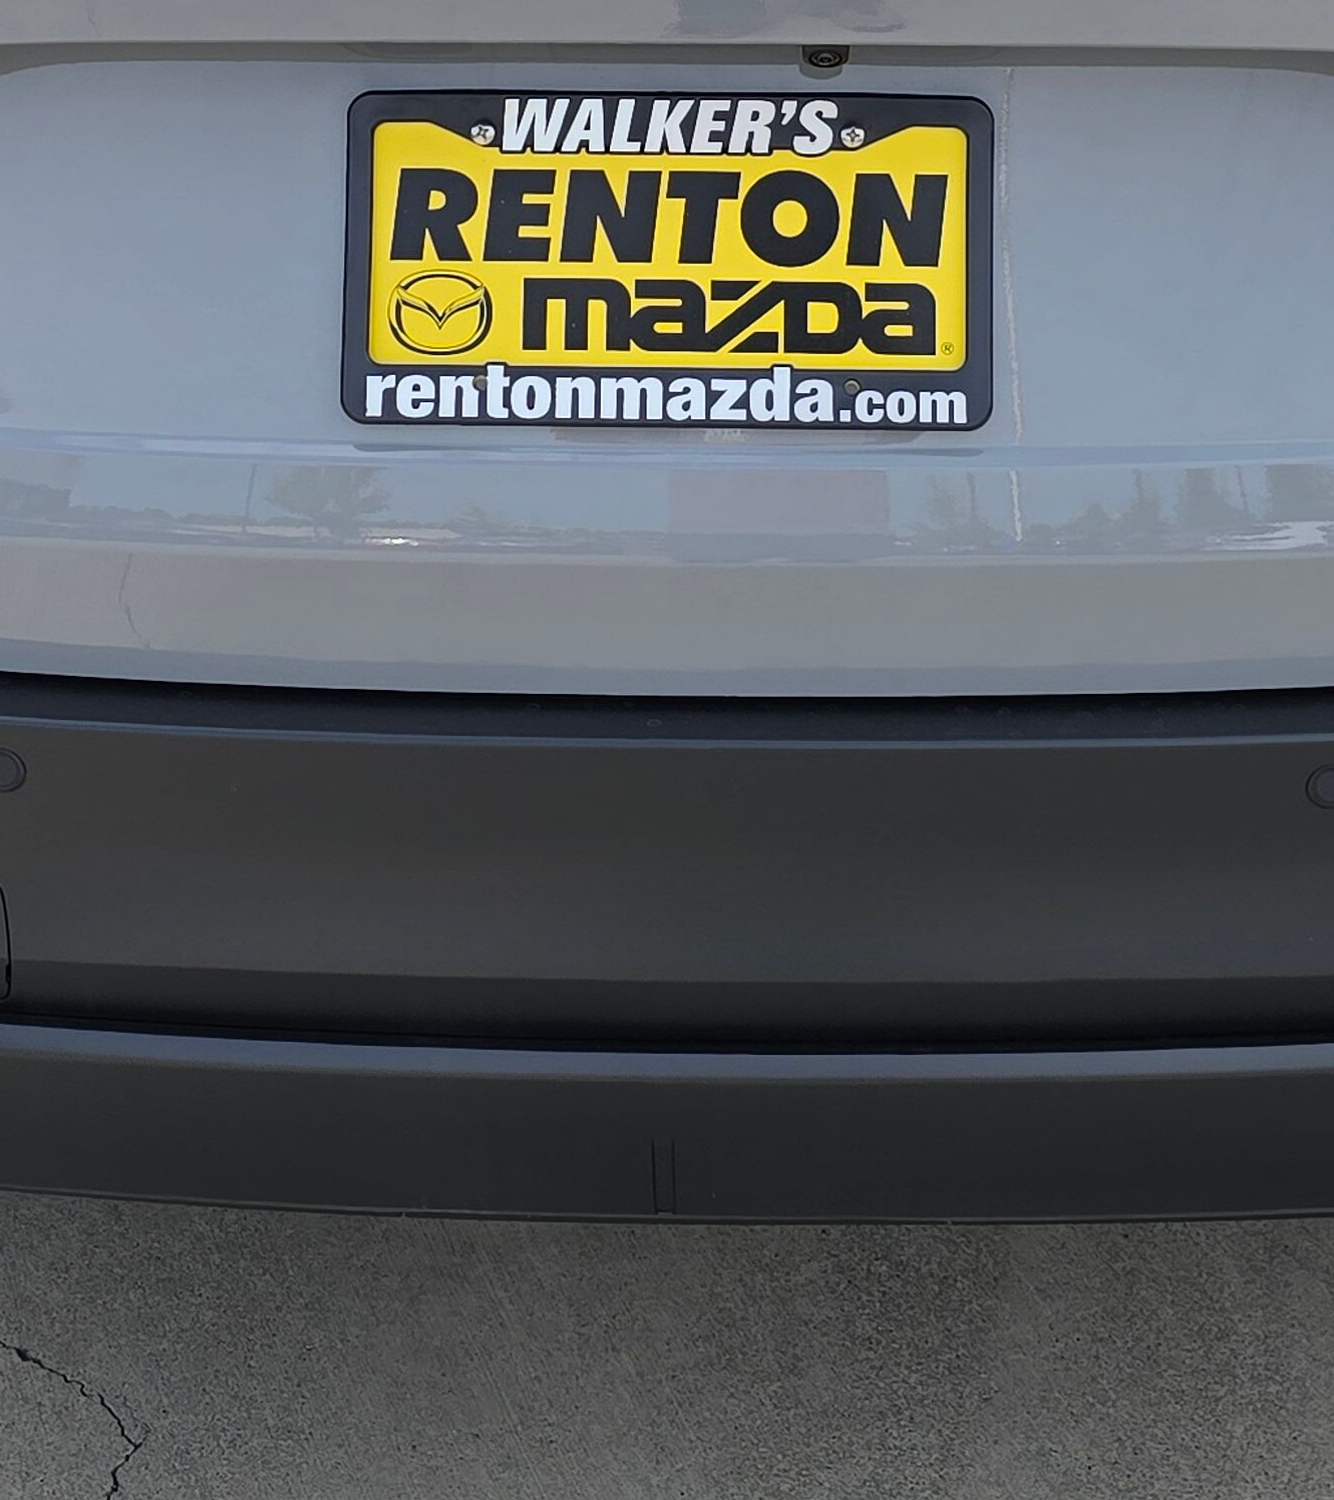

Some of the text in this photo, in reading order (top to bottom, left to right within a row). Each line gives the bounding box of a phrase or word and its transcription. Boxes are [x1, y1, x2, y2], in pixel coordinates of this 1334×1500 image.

[499, 98, 840, 156] WALKER'S
[389, 168, 949, 268] RENTON
[365, 366, 968, 424] rentonmazda.com
